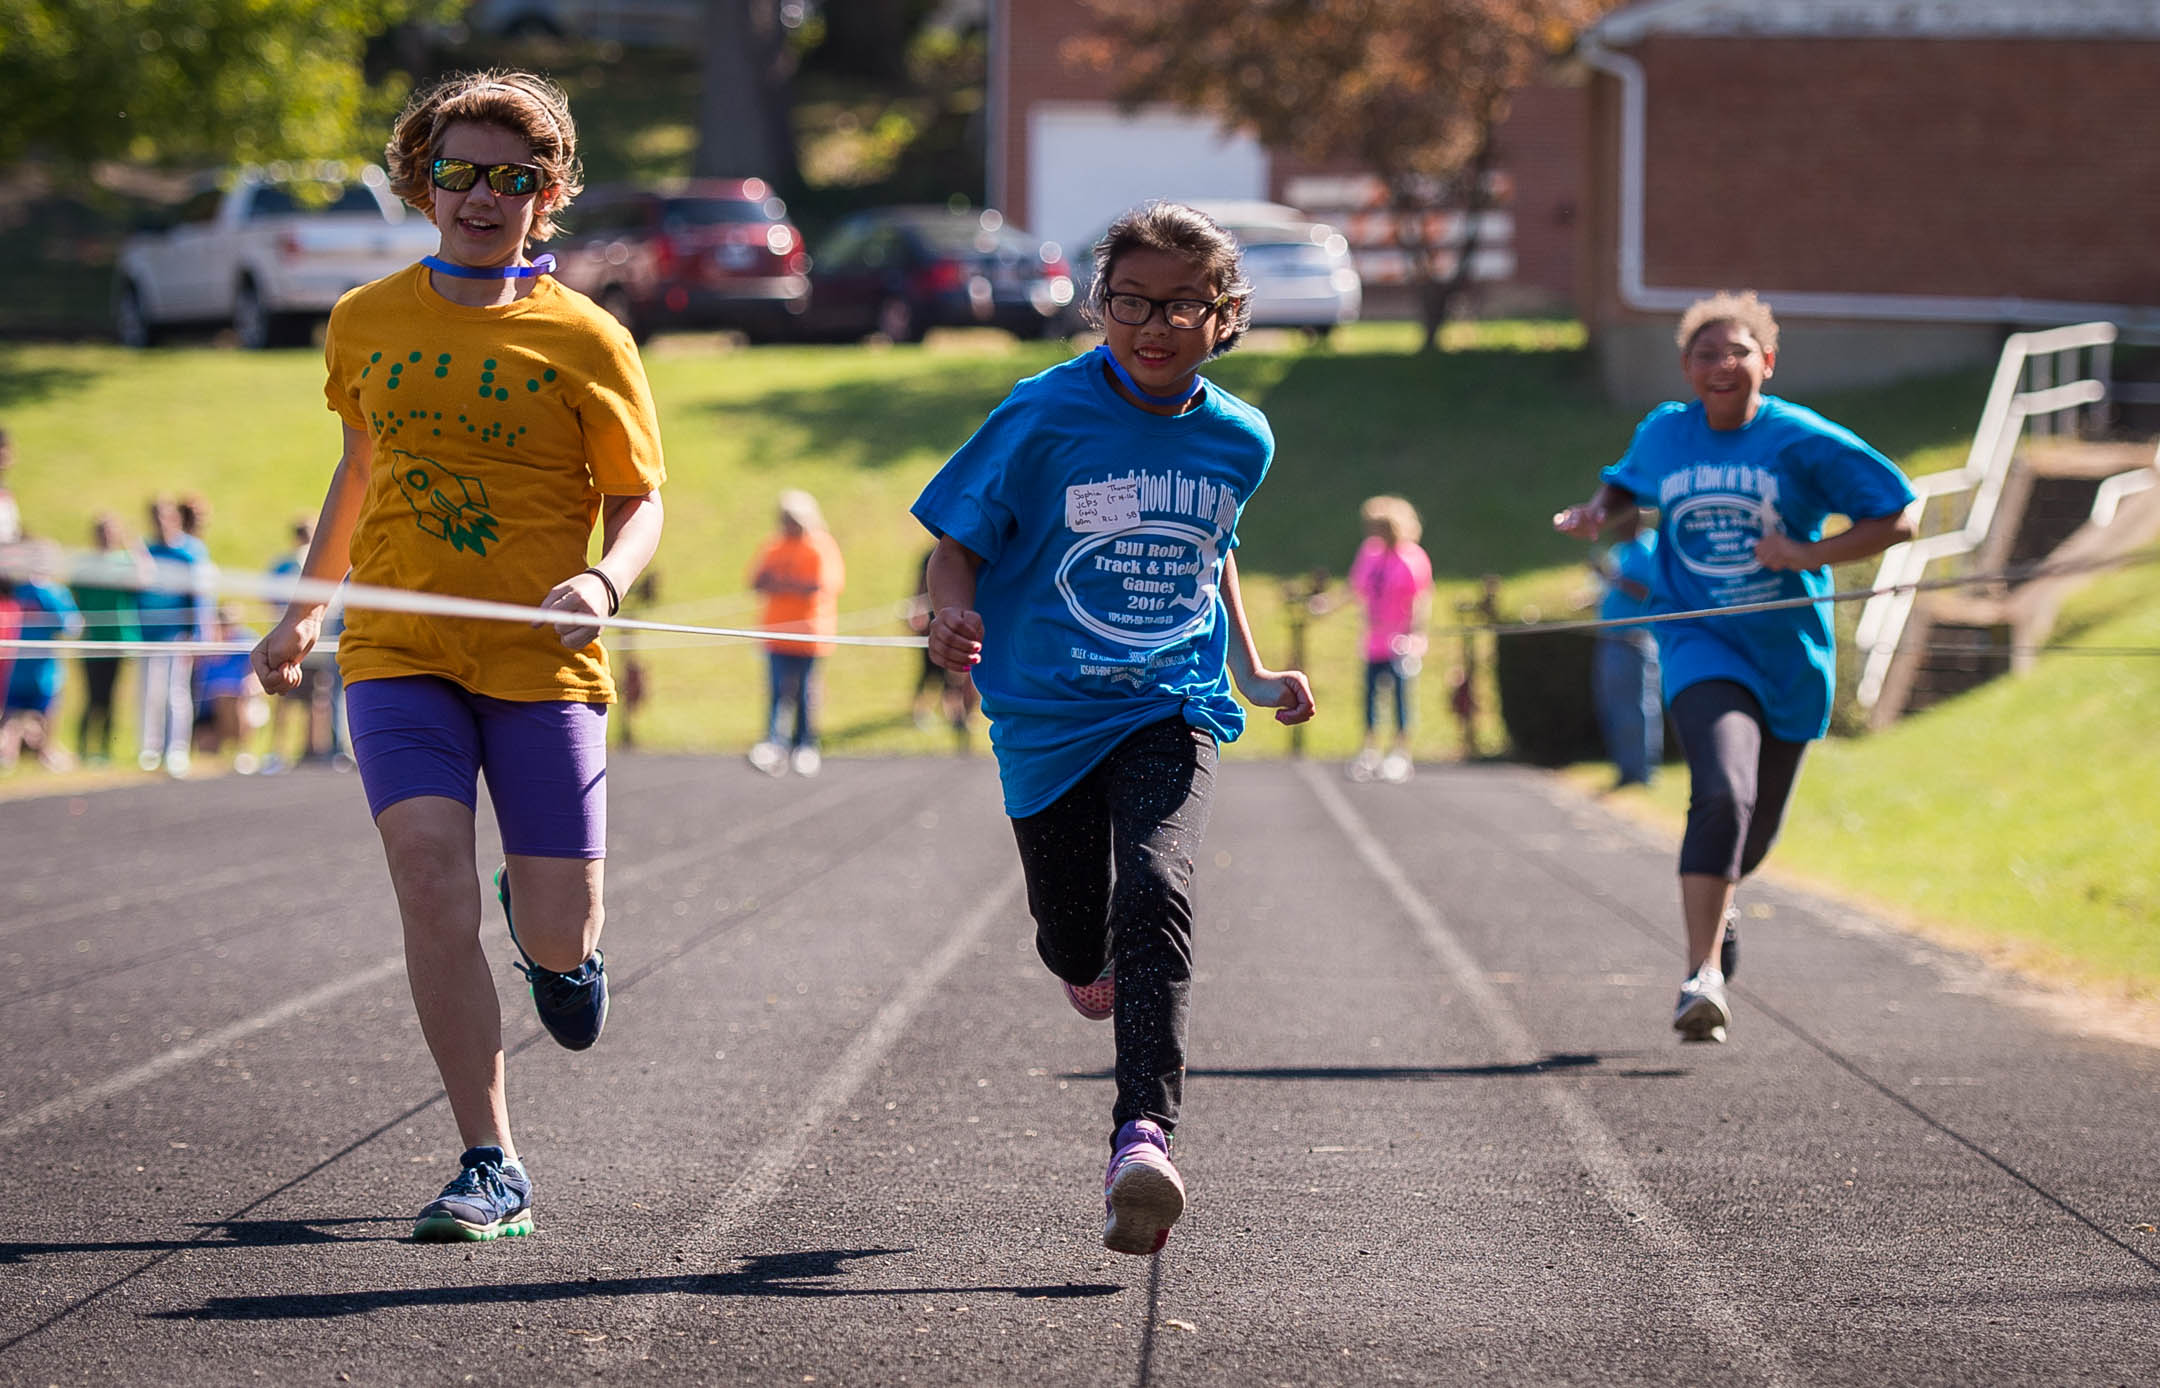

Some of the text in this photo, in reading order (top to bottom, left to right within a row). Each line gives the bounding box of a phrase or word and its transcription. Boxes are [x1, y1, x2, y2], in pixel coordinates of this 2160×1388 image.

[1073, 489, 1102, 500] Sophia
[1175, 469, 1196, 515] for
[1197, 475, 1217, 521] the
[1114, 540, 1186, 559] Bill Roby
[1094, 555, 1199, 577] Track & Field
[1122, 576, 1176, 594] Games
[1127, 595, 1166, 611] 2016
